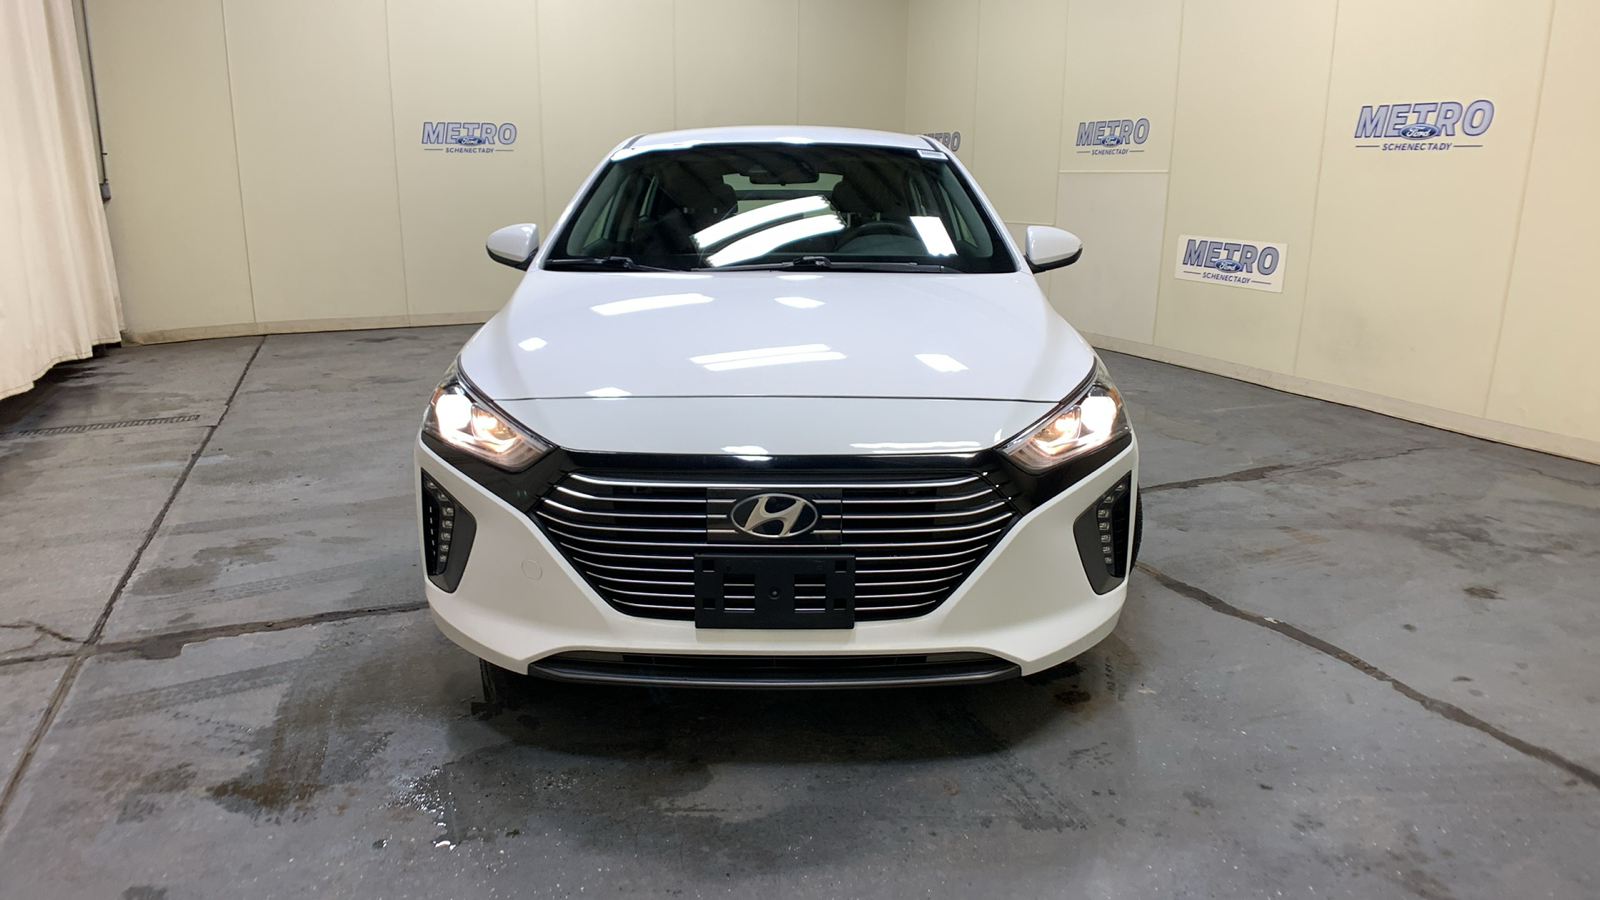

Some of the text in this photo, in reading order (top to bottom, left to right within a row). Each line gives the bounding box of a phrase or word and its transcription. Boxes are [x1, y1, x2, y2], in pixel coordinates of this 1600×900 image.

[1354, 99, 1494, 138] METRO
[422, 122, 517, 145] METRO
[1076, 118, 1150, 146] METRO
[1406, 126, 1431, 137] Ford
[1182, 239, 1279, 275] METRO
[1202, 272, 1251, 284] SCHENECTADY
